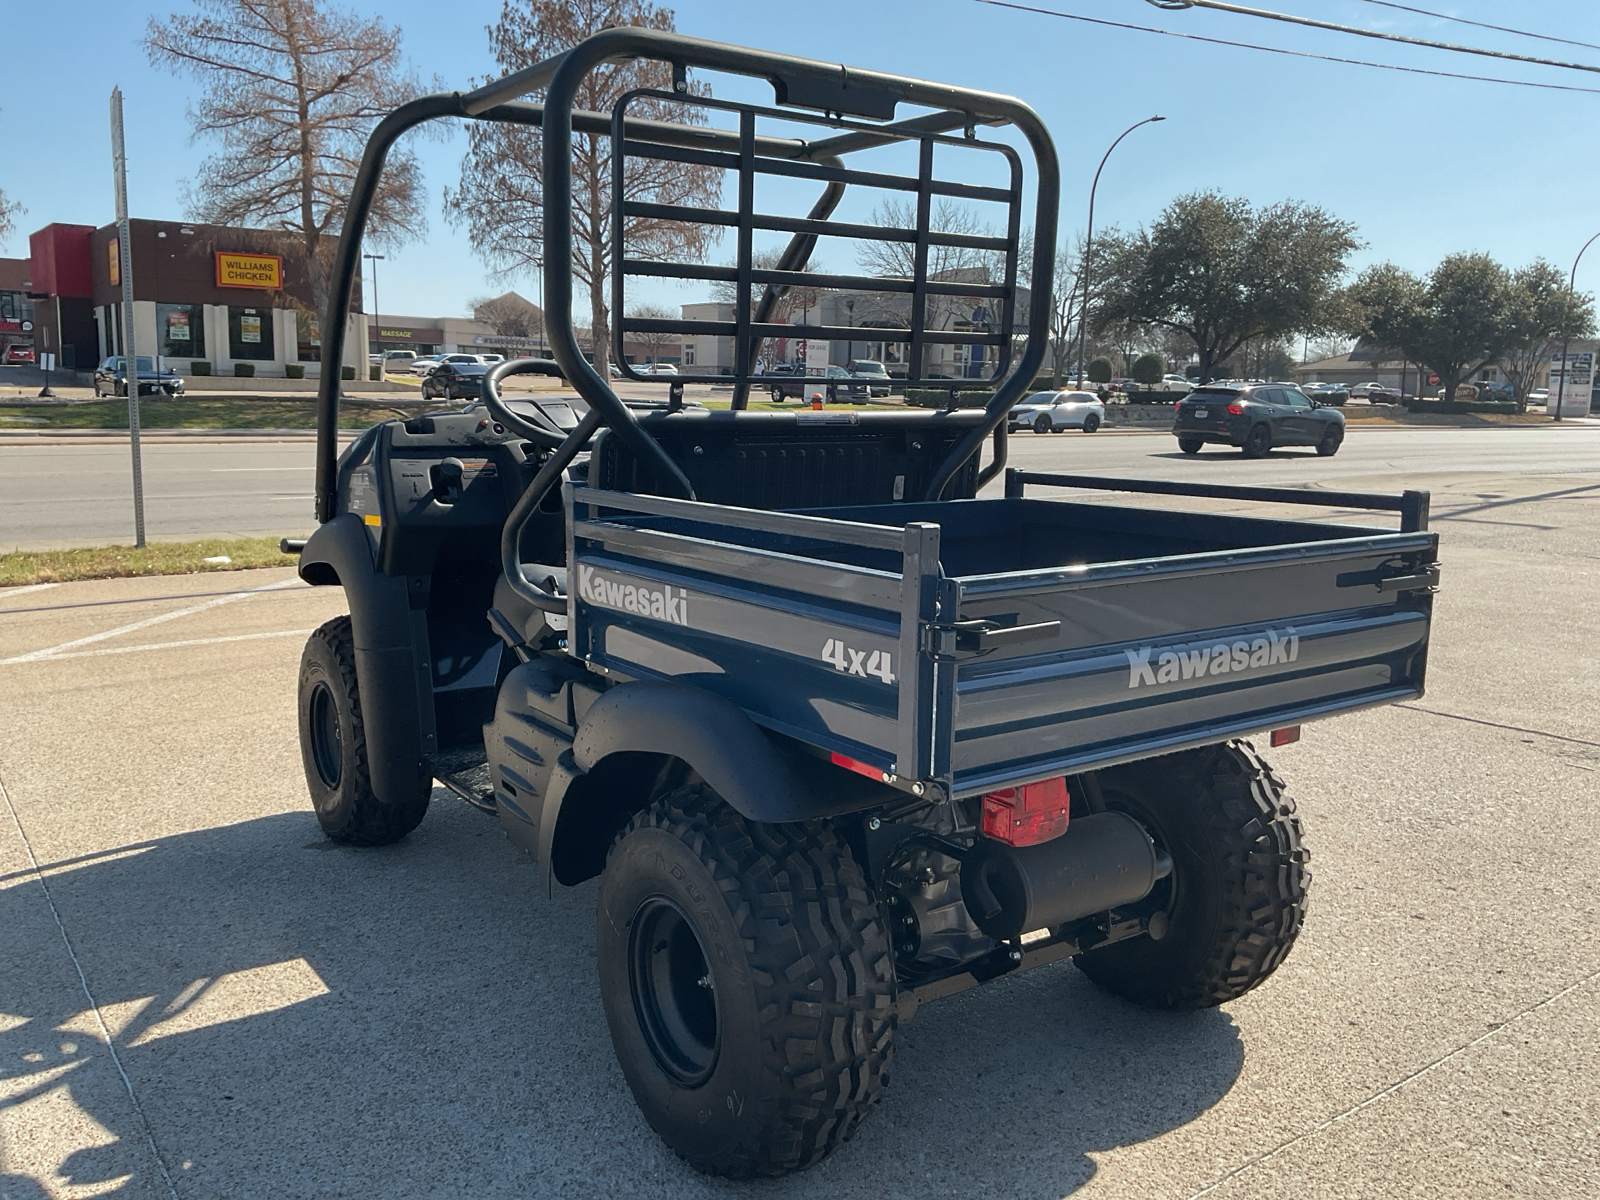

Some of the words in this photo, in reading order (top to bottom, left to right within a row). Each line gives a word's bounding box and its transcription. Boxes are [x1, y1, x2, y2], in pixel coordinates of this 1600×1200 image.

[225, 260, 274, 272] WILLIAMS
[227, 270, 272, 281] CHICKEN
[380, 330, 412, 338] MASSAGE
[577, 564, 689, 626] Kawasaki
[821, 638, 896, 685] 4x4
[1123, 625, 1300, 689] Kawasaki
